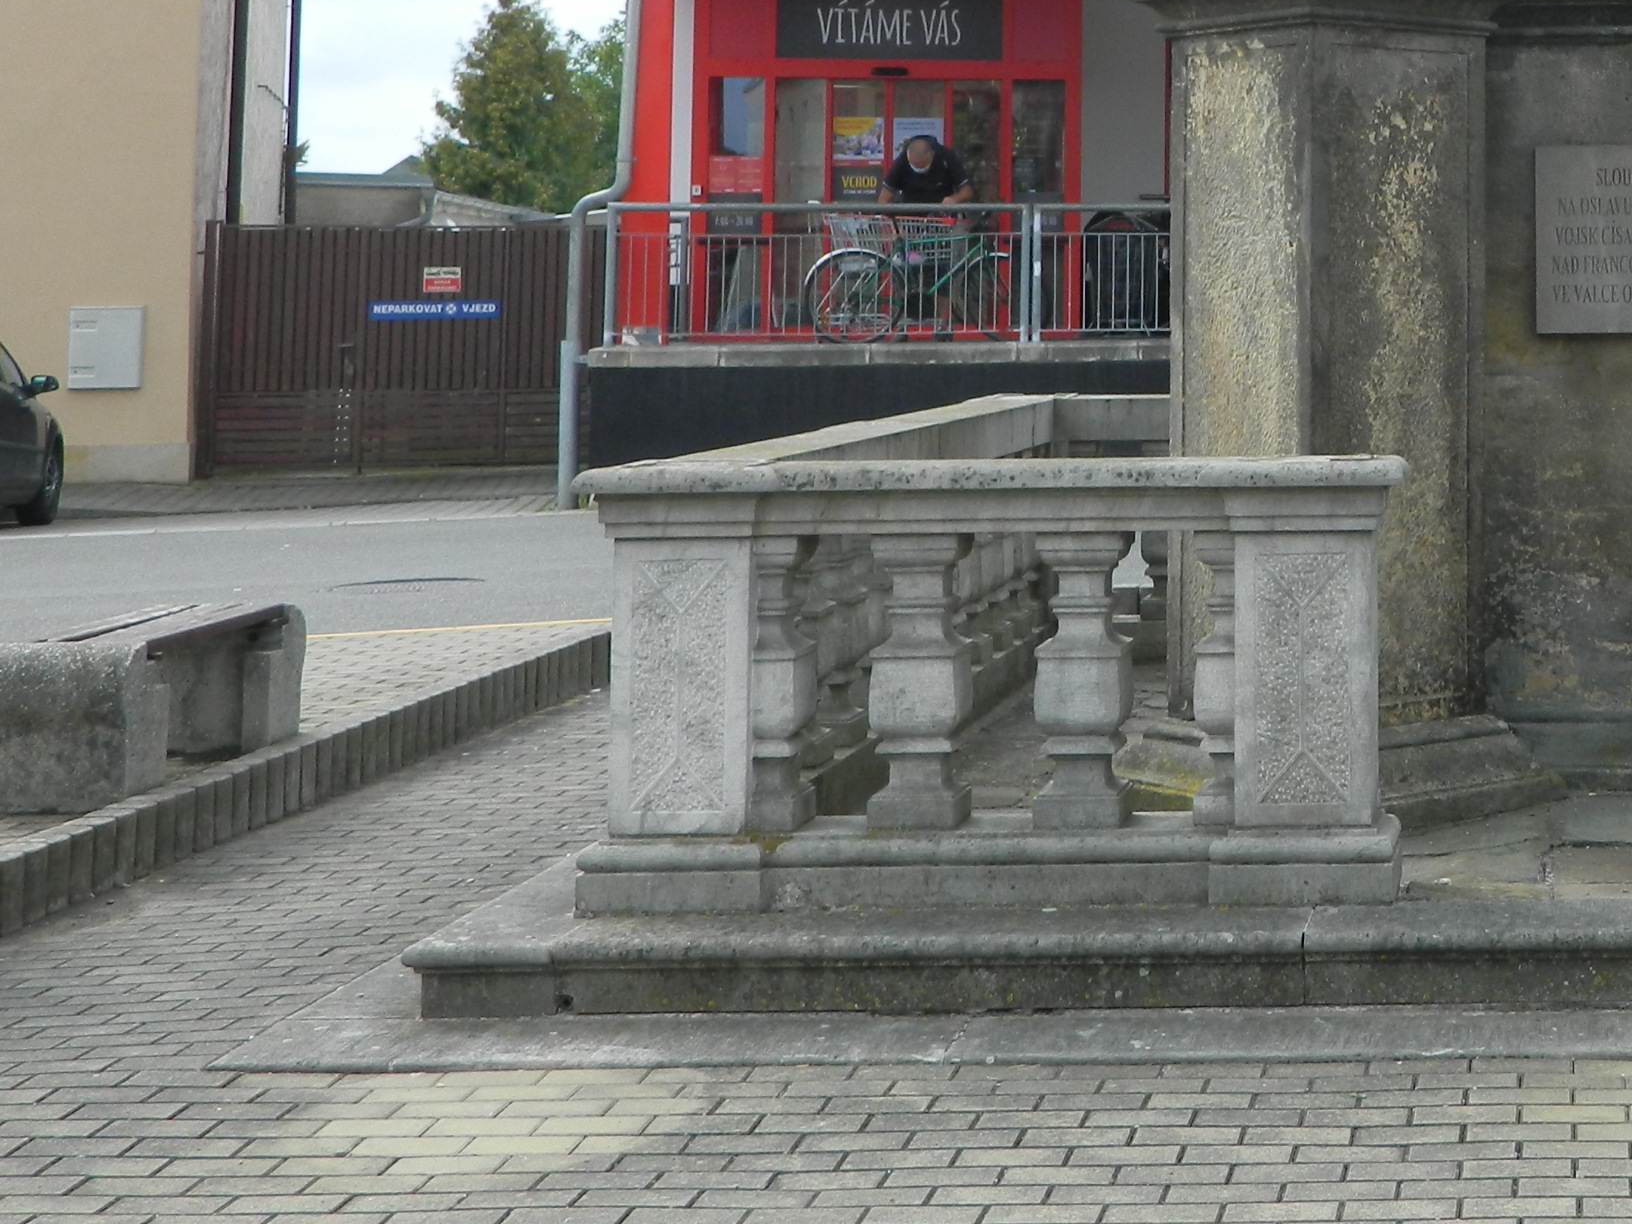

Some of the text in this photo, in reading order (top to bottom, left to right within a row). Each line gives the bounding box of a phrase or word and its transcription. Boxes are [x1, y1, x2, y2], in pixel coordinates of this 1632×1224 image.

[920, 0, 961, 45] VÁS
[1558, 197, 1575, 215] NA
[1580, 197, 1632, 215] OSLAVU
[1555, 226, 1599, 245] VOJSK
[1551, 256, 1580, 274] NAD
[1552, 284, 1570, 303] VE
[1622, 284, 1632, 303] O
[373, 303, 497, 314] NEPARKOVAT VJEZD
